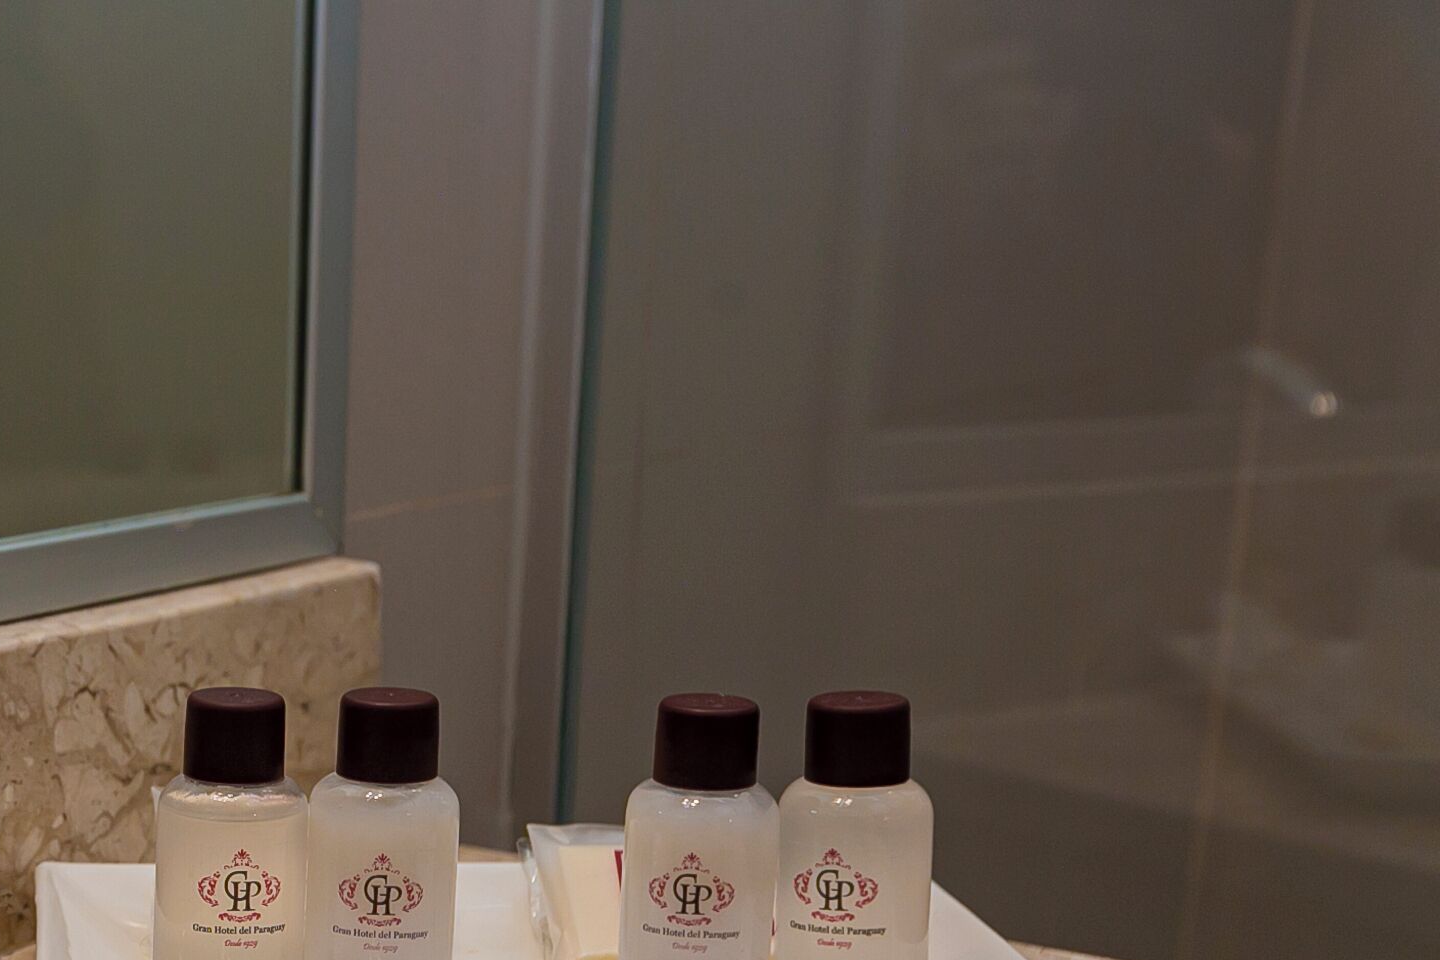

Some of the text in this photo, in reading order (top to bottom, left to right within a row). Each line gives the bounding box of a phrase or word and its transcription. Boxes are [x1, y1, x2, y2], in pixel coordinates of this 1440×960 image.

[192, 923, 286, 934] Gran Hotel del Paraguay
[332, 925, 428, 940] Gran Hotel del Paraguay
[642, 923, 740, 940] Gran Hotel del Paraguay
[790, 920, 886, 936] Gran Hotel del Paraguay
